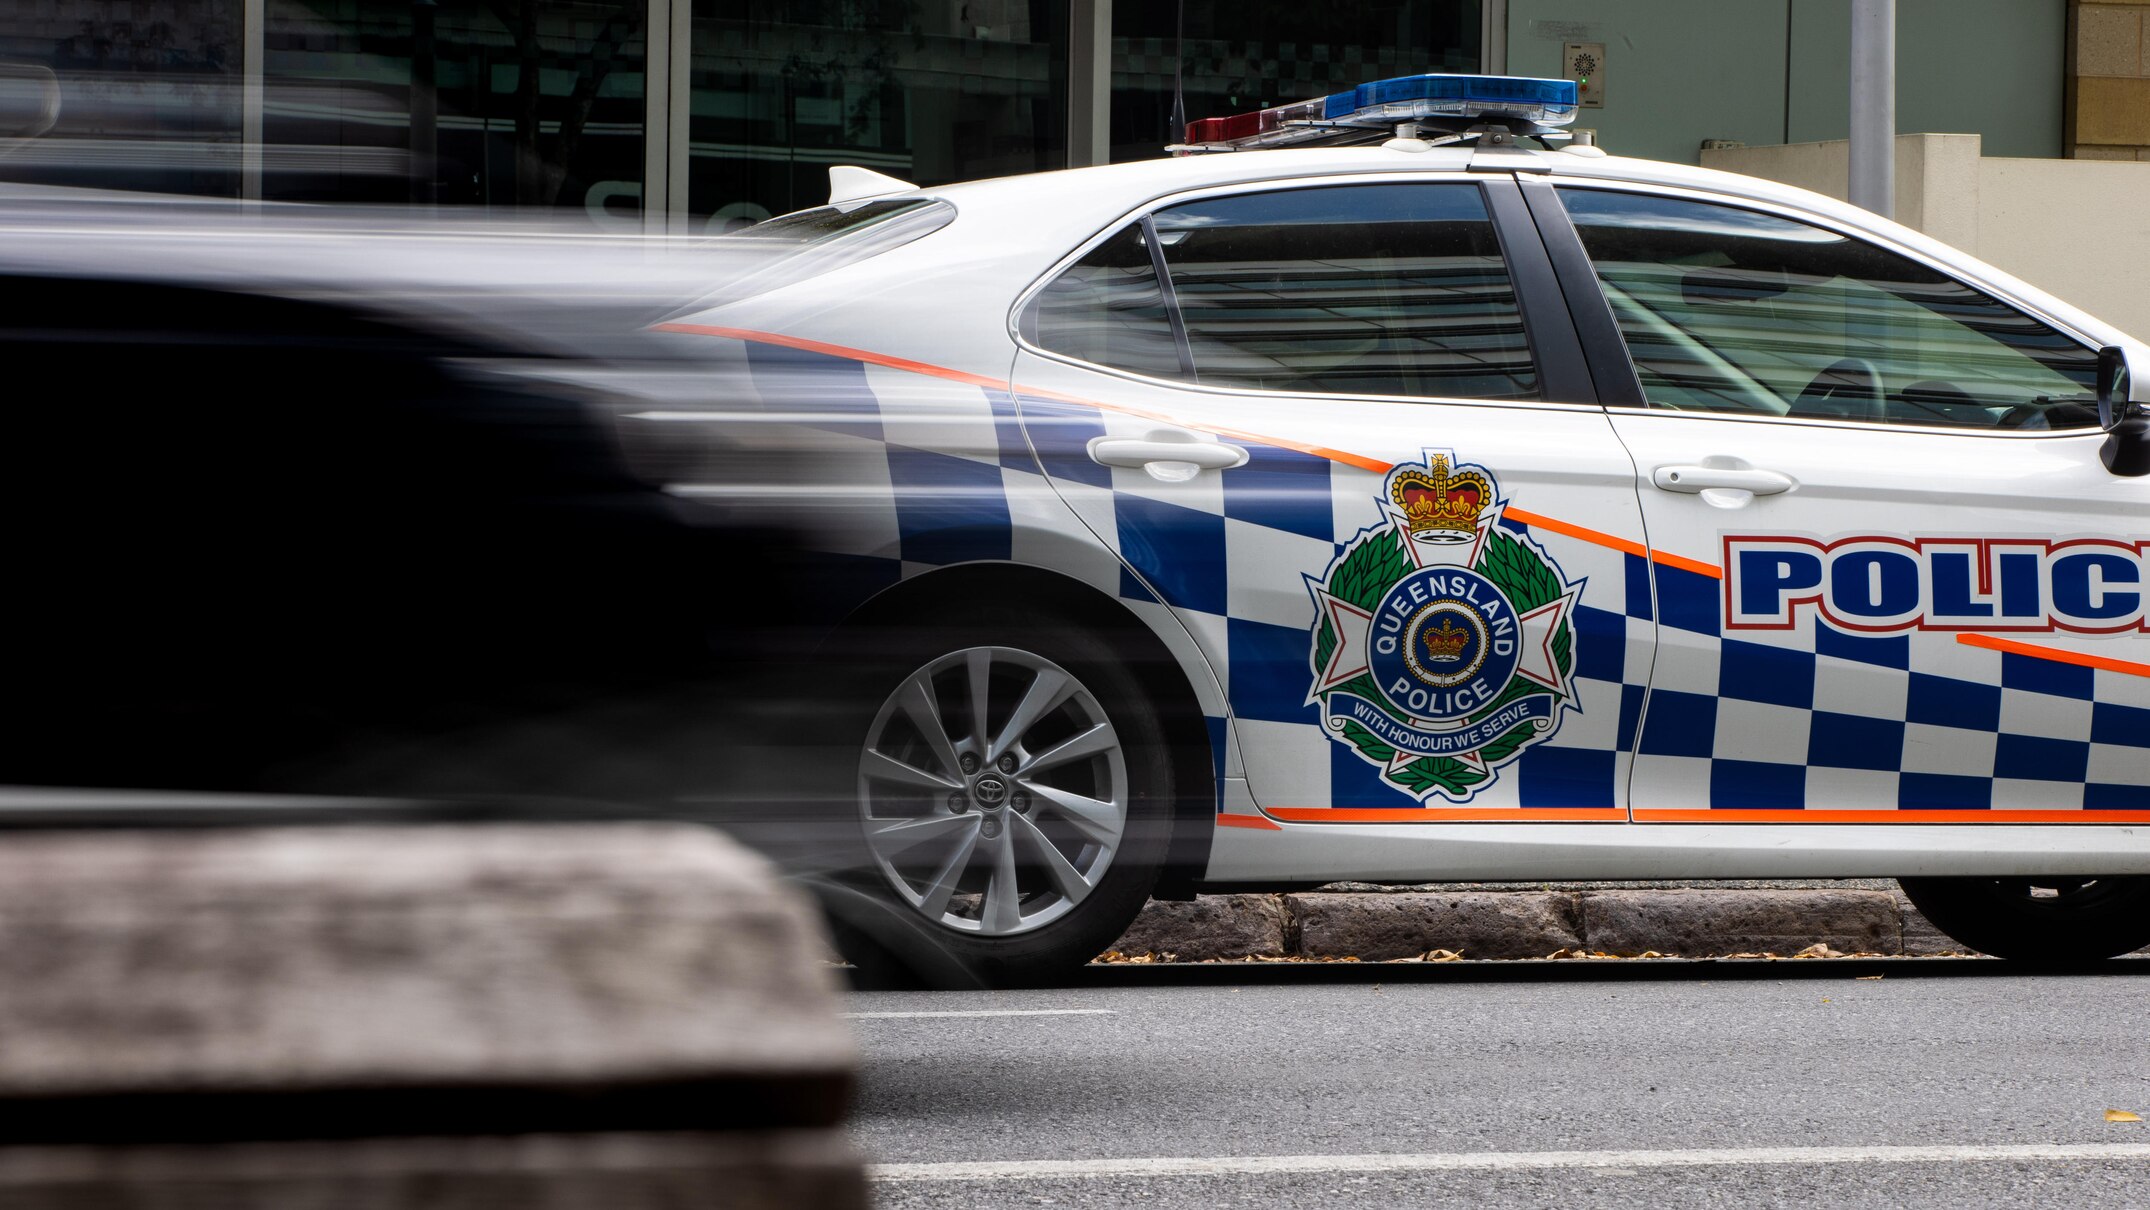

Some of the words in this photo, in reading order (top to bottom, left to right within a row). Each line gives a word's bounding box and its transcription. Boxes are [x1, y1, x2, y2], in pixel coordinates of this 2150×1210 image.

[1377, 576, 1513, 655] QUEENSLAND
[1732, 543, 2150, 625] POLIC
[1354, 703, 1388, 733] WITH
[1389, 727, 1452, 750] HONOUR
[1455, 730, 1480, 748] WE
[1482, 703, 1529, 737] SERVE
[1389, 678, 1493, 713] POLICE
